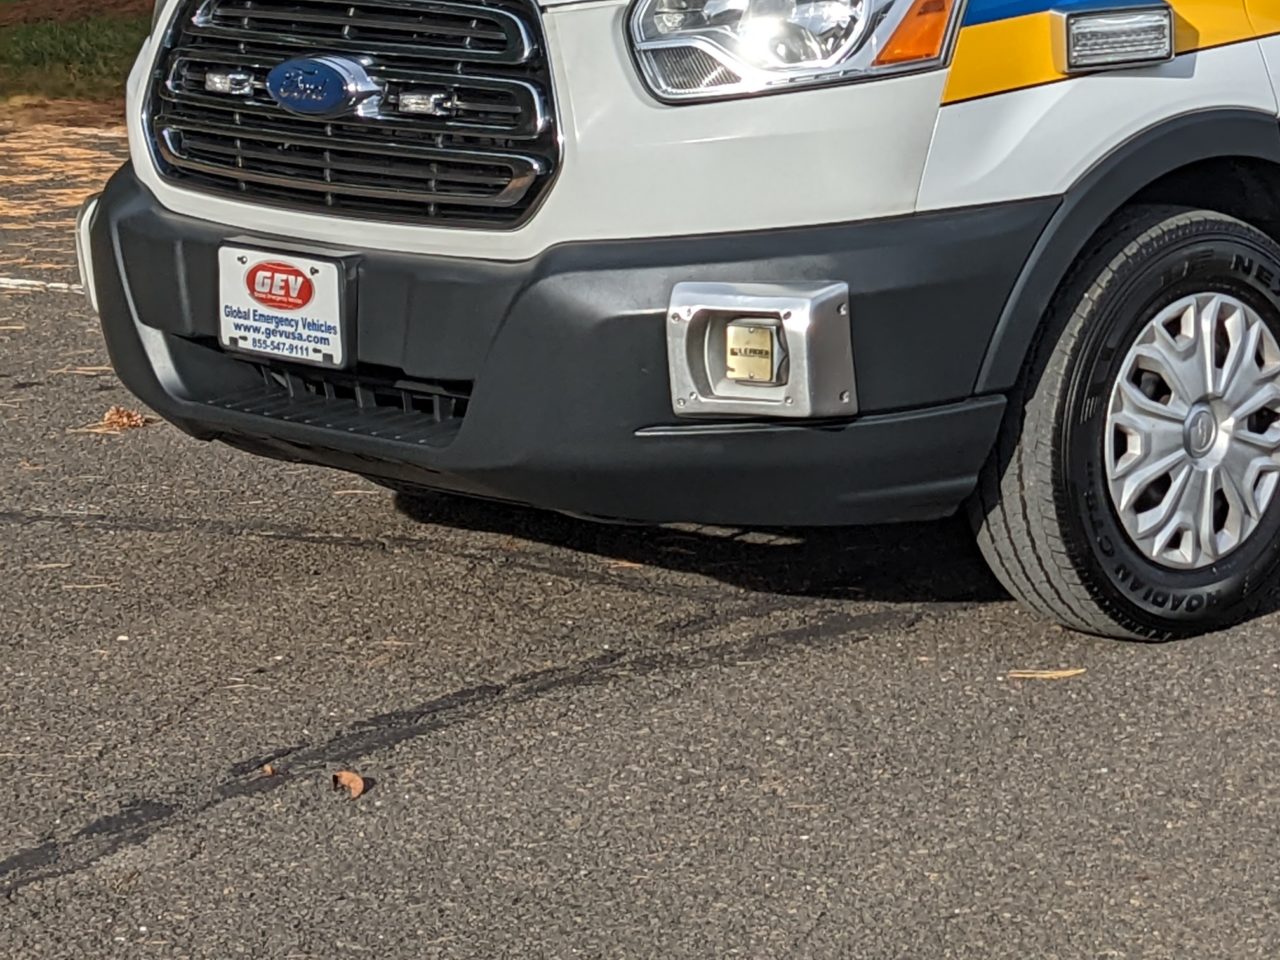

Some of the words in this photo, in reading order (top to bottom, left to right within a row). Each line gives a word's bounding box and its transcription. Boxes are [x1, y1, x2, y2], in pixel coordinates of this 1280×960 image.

[279, 68, 329, 100] Ford
[254, 270, 304, 299] GEV
[224, 304, 251, 321] Global
[252, 309, 300, 332] Emergency
[301, 317, 338, 336] Vehicles
[233, 322, 331, 346] www.gevusa.com
[251, 337, 310, 357] 855-547-9111
